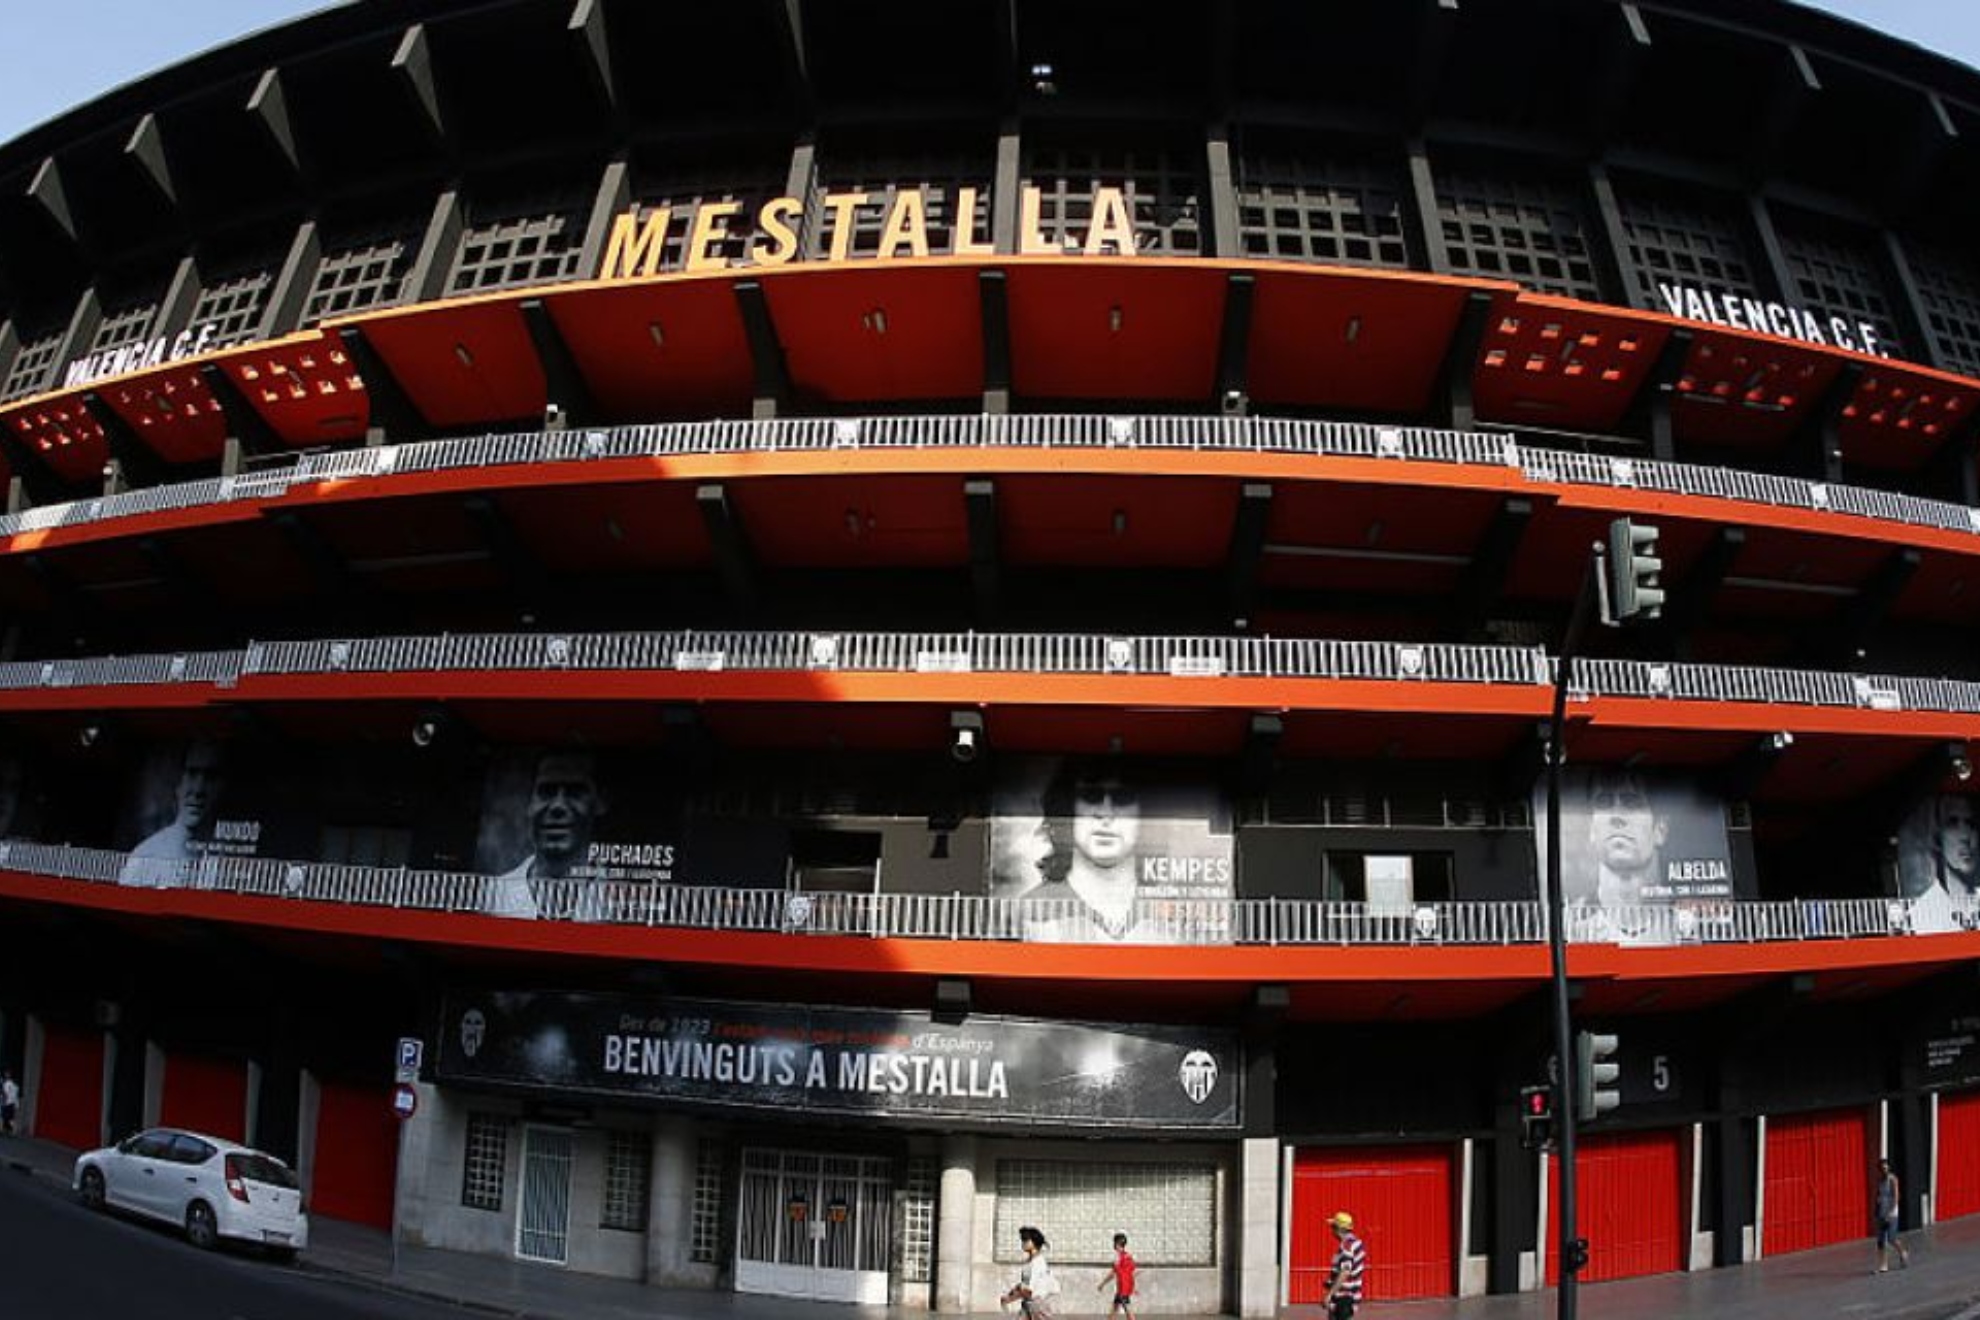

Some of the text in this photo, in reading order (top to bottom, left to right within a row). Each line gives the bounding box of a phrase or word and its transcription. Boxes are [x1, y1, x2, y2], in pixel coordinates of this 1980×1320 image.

[600, 186, 1138, 279] MESTALLA
[1660, 283, 1889, 358] VALENCIA C.F.
[63, 336, 167, 389] VALENCIA
[587, 842, 674, 866] PUCHADES
[1143, 857, 1229, 883] KEMPES
[1668, 861, 1727, 881] ALBELDA
[604, 1035, 1008, 1099] BENVINGUTS A MESTALLA
[1653, 1056, 1669, 1090] 5
